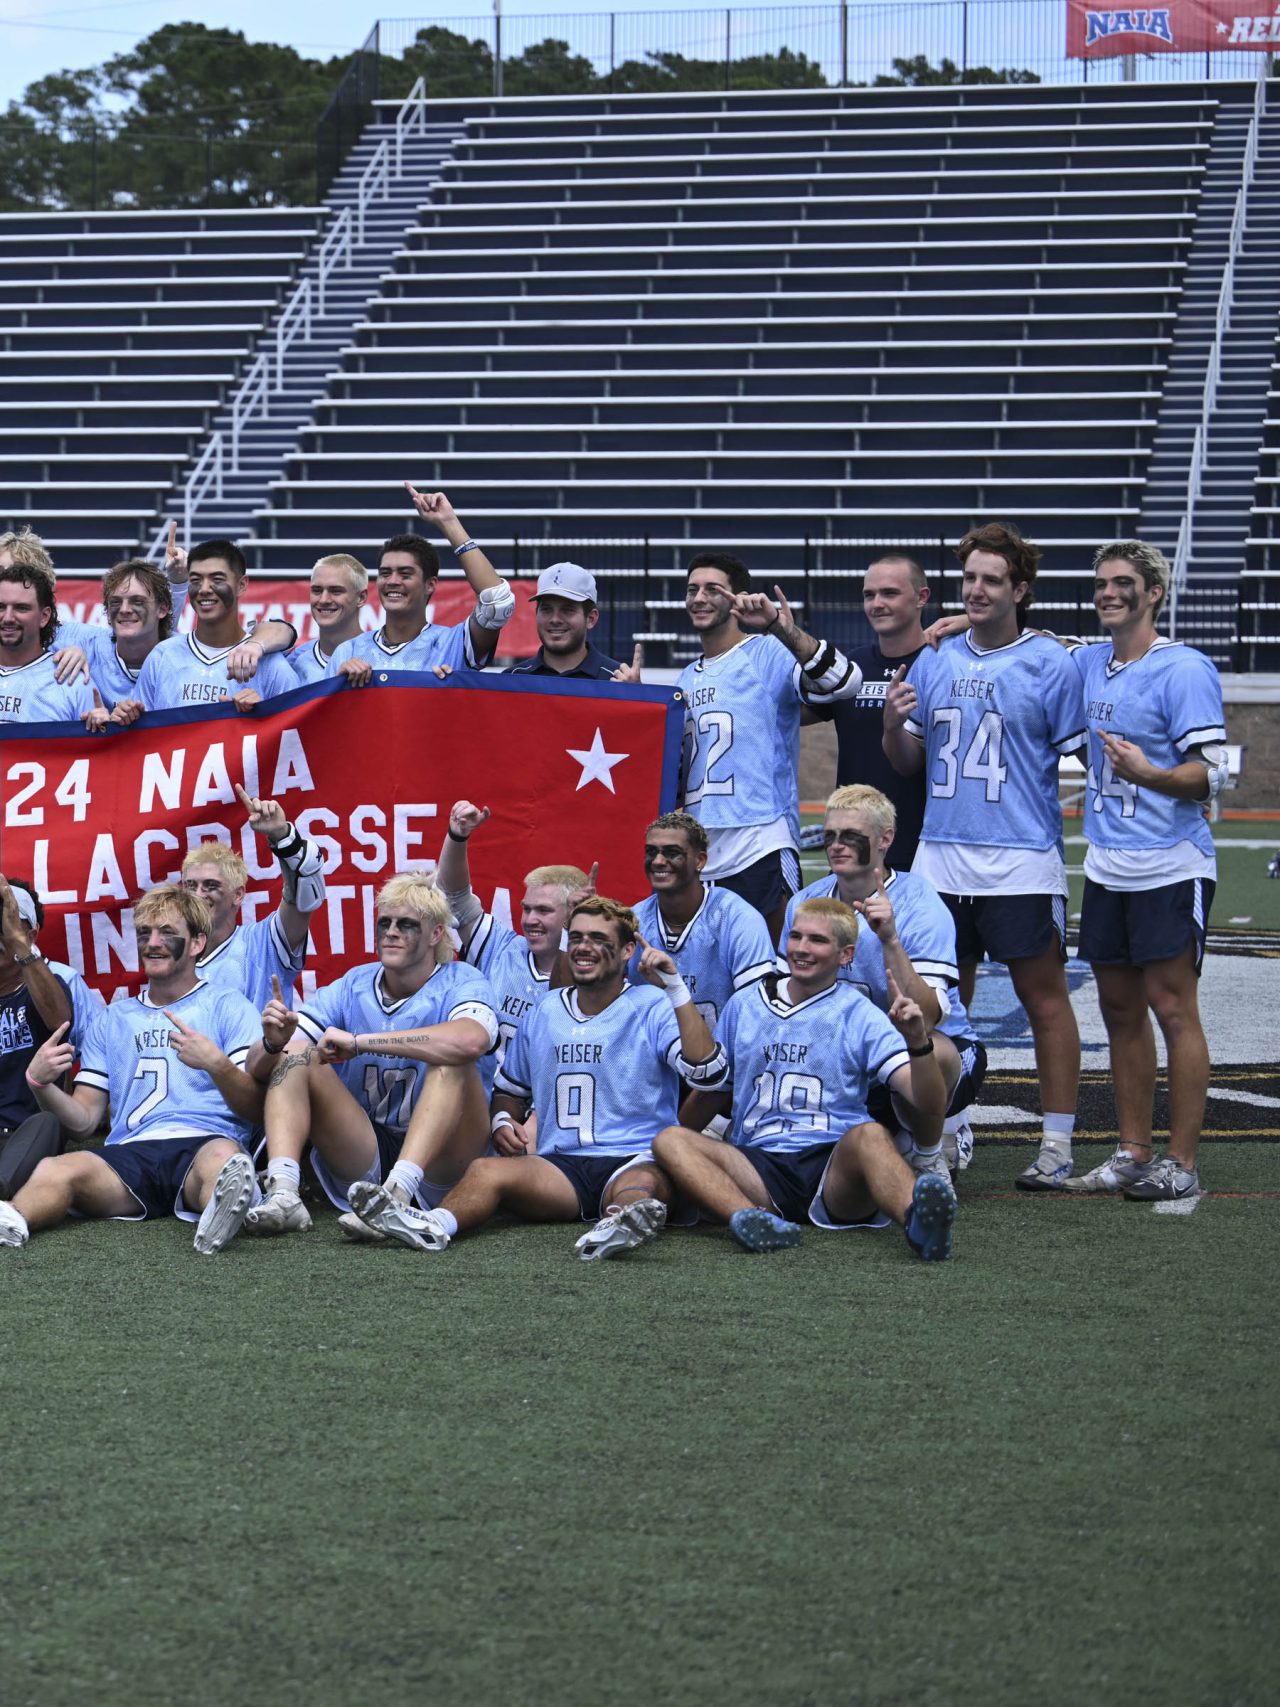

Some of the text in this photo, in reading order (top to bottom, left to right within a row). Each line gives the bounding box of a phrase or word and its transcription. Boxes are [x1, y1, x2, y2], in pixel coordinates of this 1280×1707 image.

[1085, 9, 1172, 46] NAIA
[686, 687, 716, 711] EISER
[855, 700, 884, 709] LACR
[950, 679, 995, 701] KEISER
[138, 728, 316, 814] NAIA
[931, 706, 1009, 804] 34
[406, 1034, 430, 1043] BOATS
[126, 1056, 169, 1132] 2
[554, 1071, 597, 1153] 9
